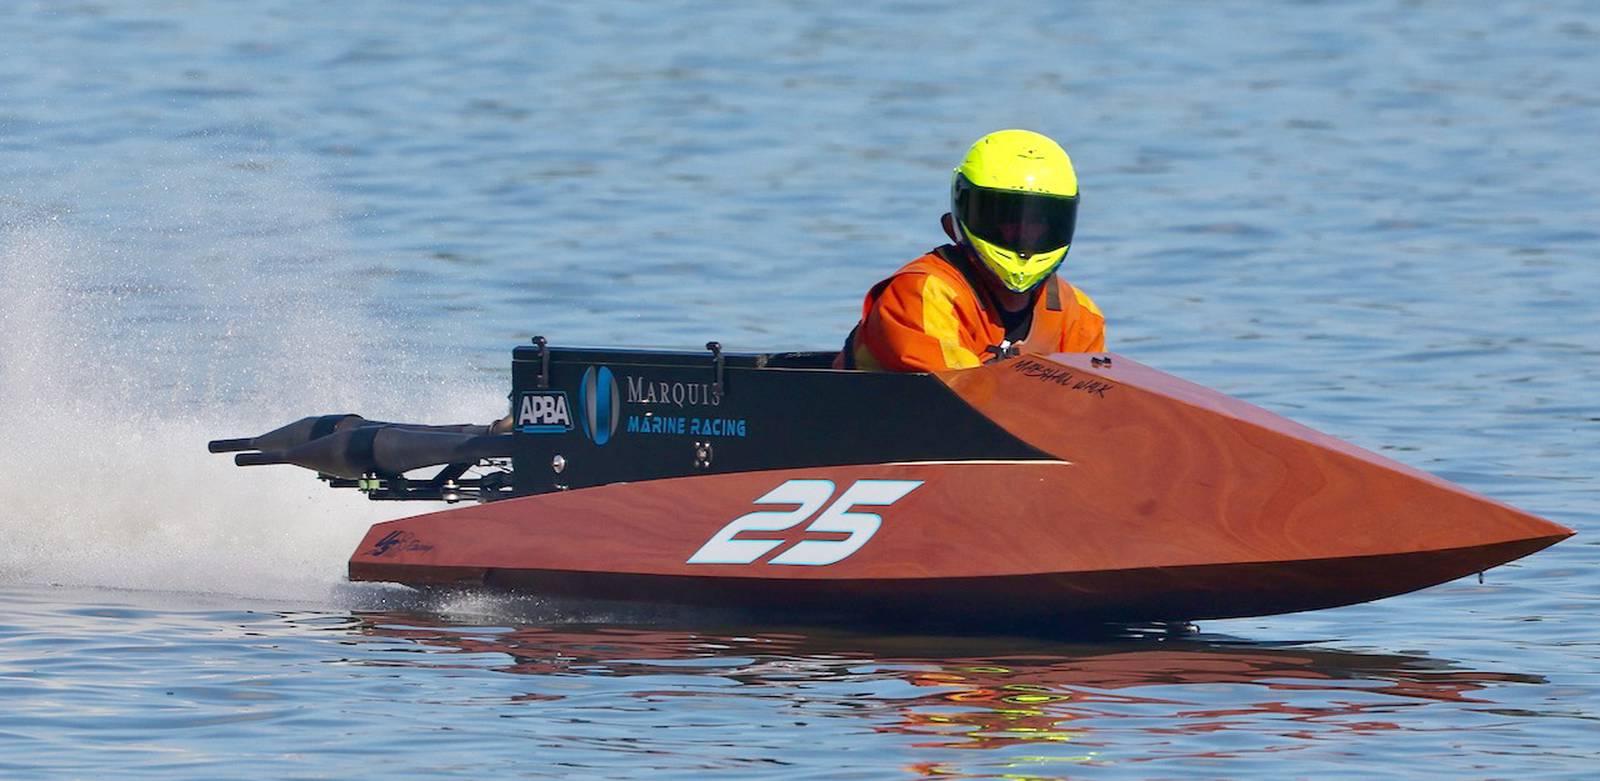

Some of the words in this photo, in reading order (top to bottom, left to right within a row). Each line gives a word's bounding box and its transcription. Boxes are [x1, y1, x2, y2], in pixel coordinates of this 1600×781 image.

[518, 396, 570, 426] APBA
[627, 415, 685, 435] MARINE
[690, 418, 746, 437] RACING
[685, 479, 926, 566] 25
